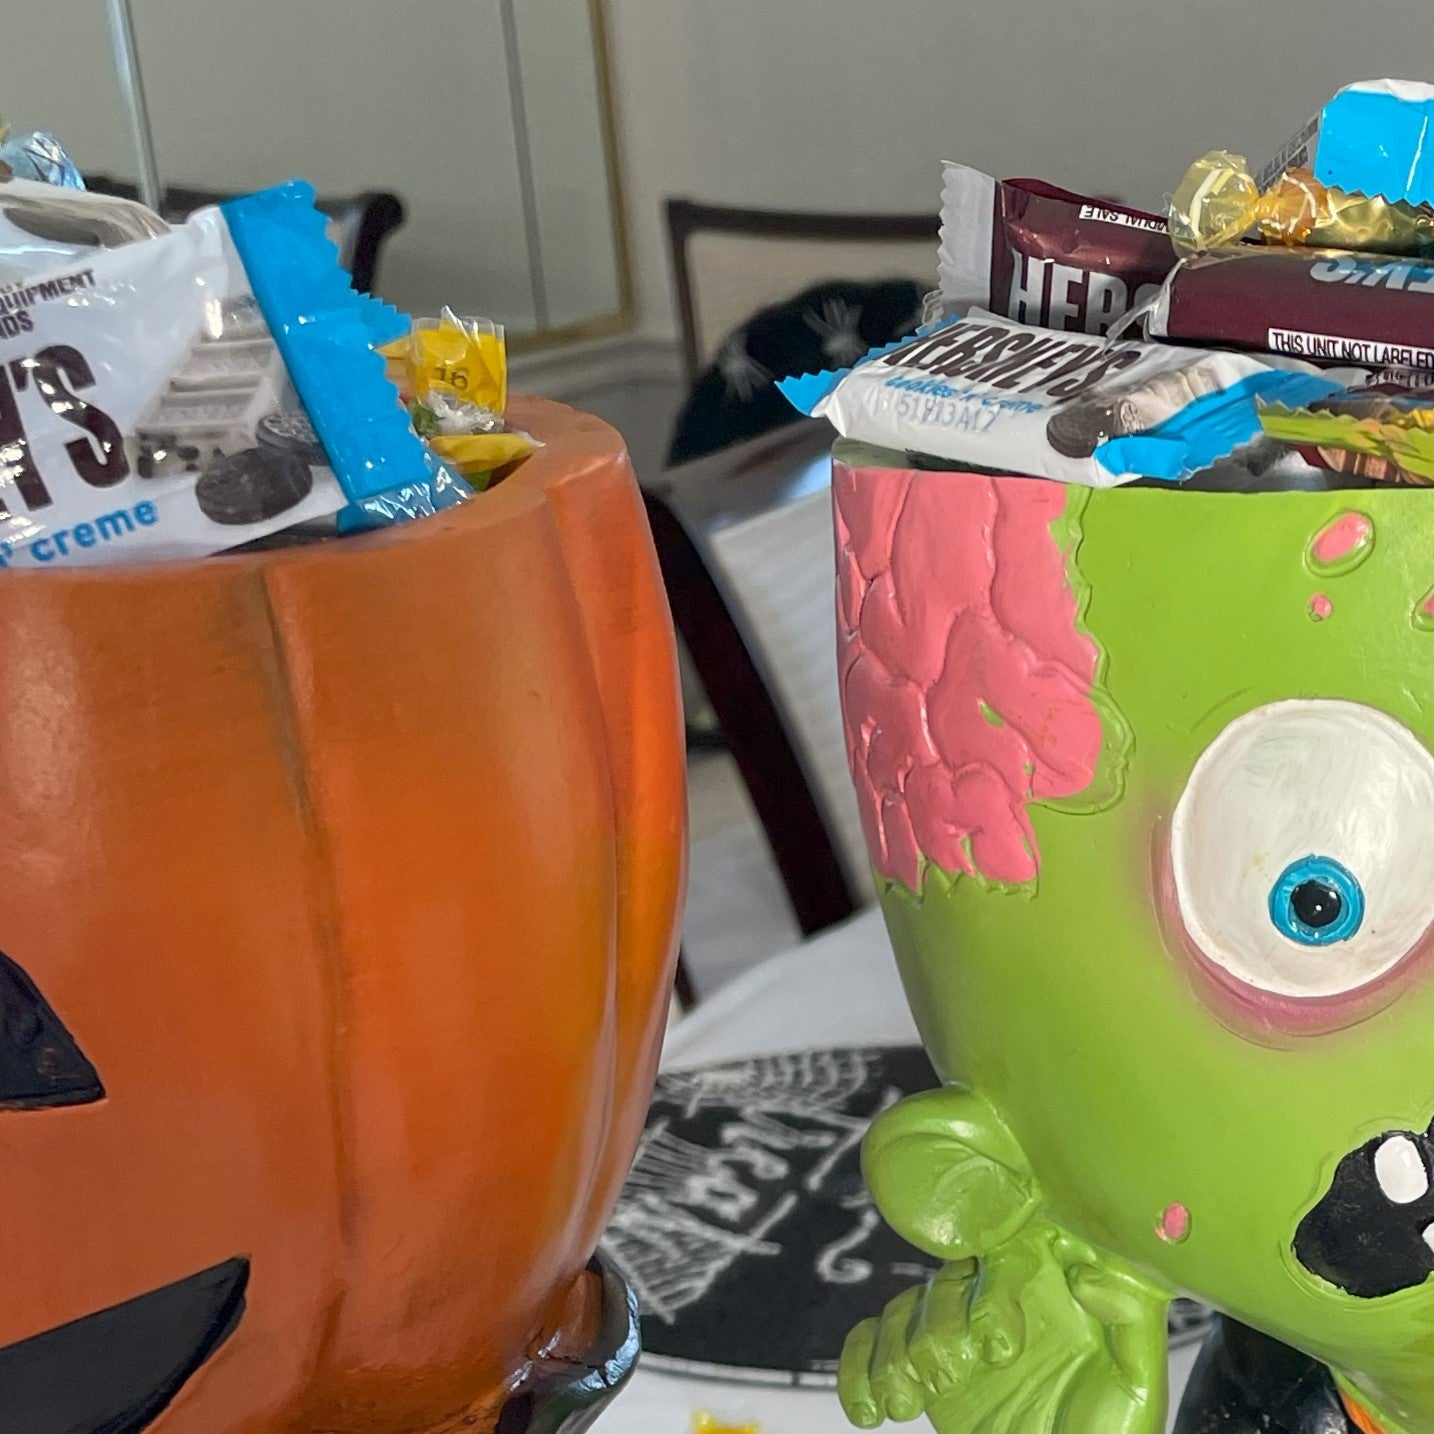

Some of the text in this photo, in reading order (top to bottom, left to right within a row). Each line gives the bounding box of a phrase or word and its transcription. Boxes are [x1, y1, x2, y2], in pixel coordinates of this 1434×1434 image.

[1272, 331, 1304, 354] THIS
[1306, 336, 1339, 358] UNIT
[1341, 340, 1371, 362] NOT
[30, 499, 158, 563] creme
